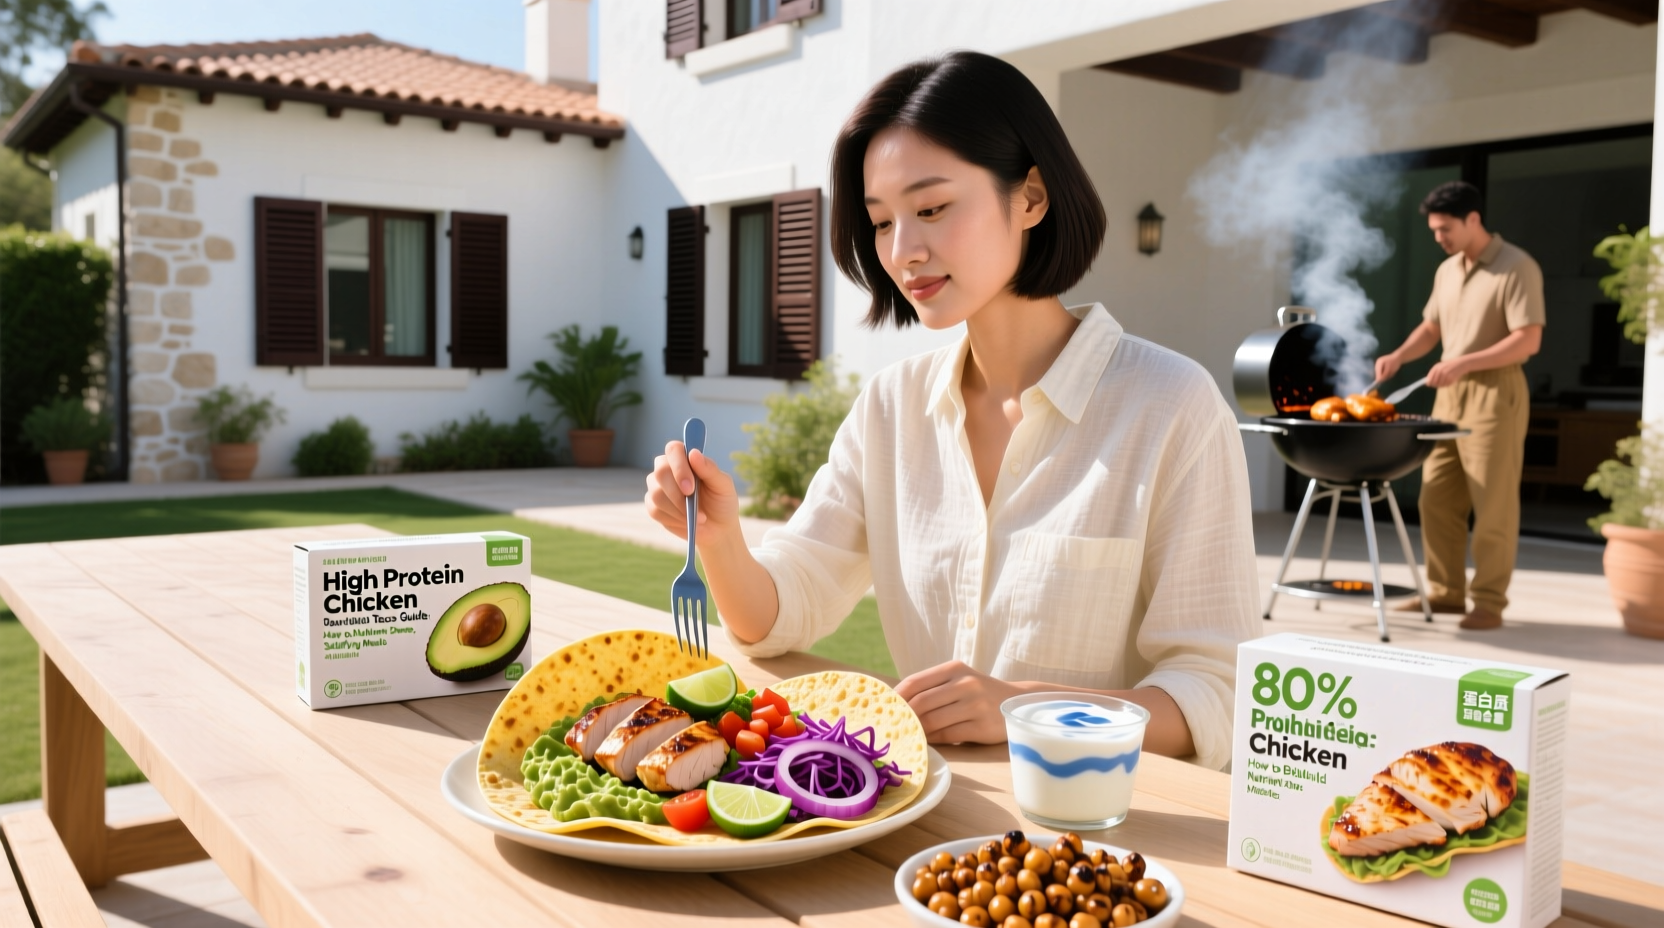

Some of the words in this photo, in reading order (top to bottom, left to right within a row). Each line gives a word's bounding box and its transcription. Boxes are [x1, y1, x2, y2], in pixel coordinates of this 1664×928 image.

[323, 569, 378, 595] High
[383, 564, 464, 588] Protein
[323, 592, 418, 614] Chicken
[1252, 662, 1358, 719] 80%
[1249, 732, 1347, 770] Chicken
